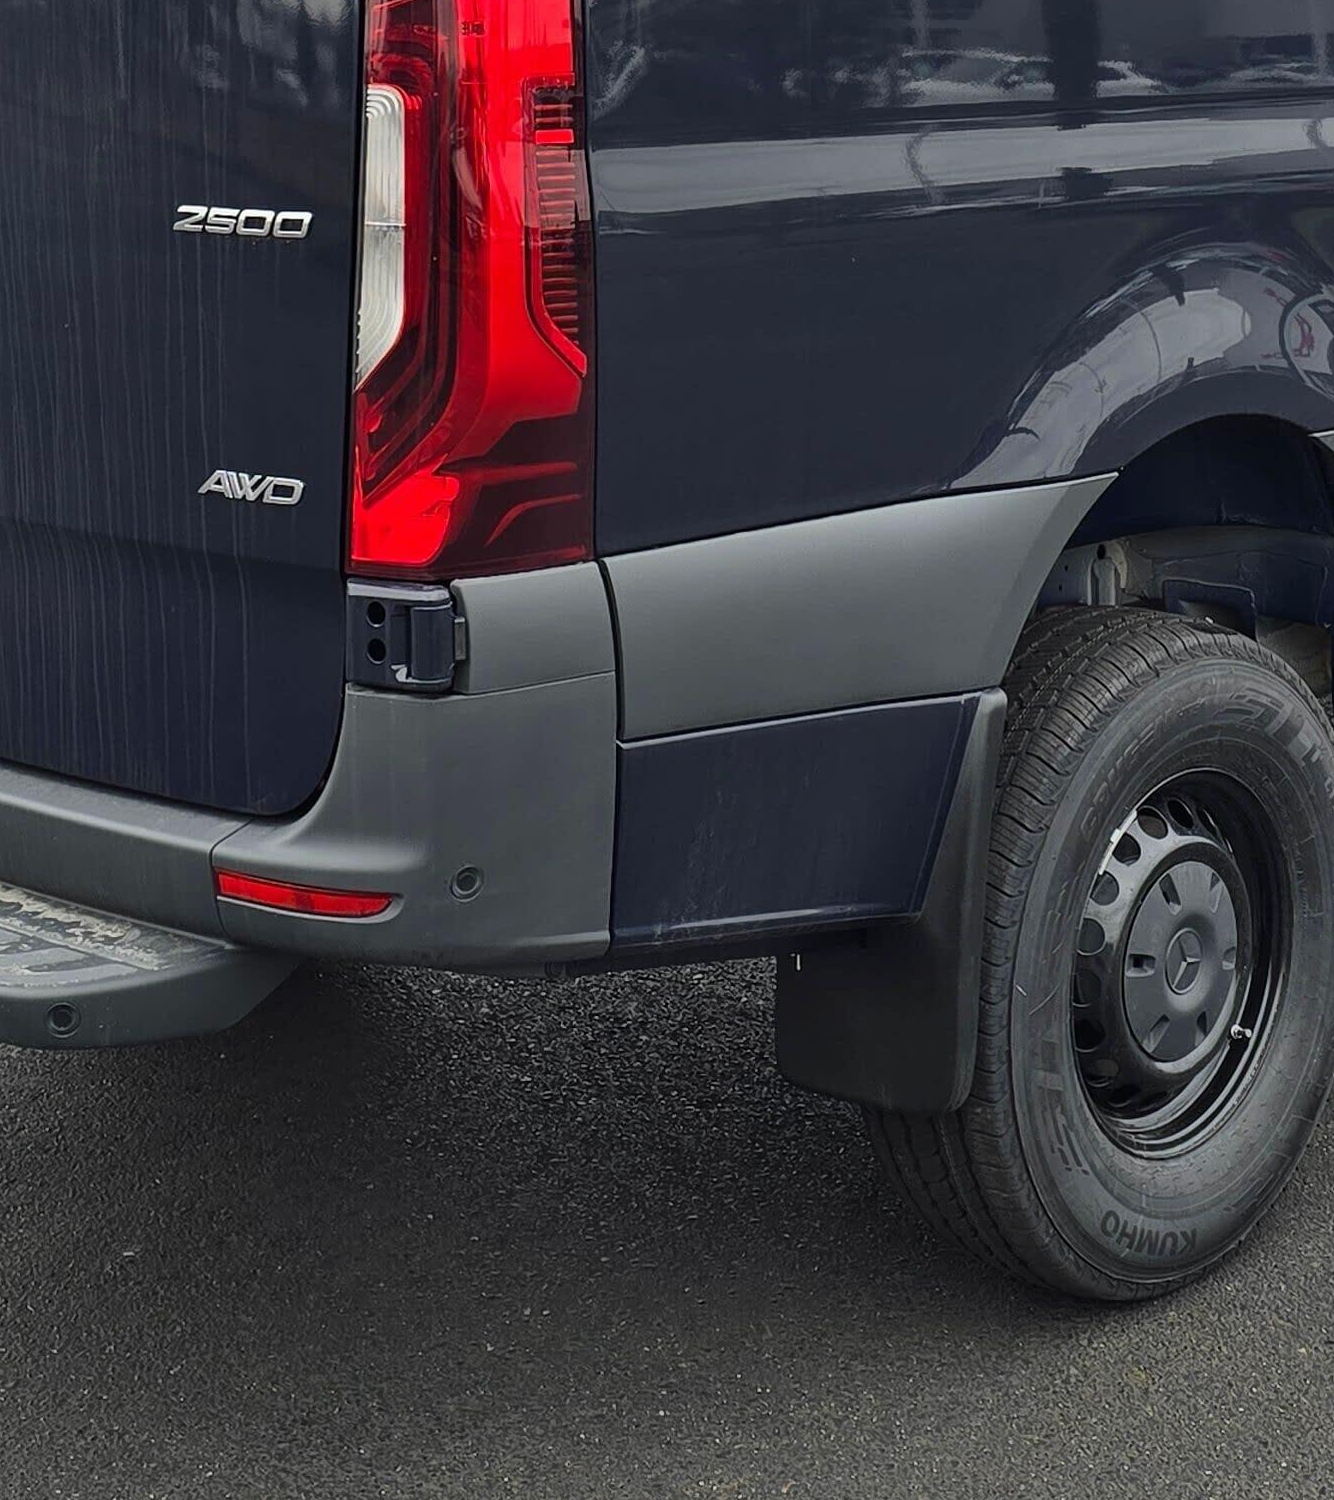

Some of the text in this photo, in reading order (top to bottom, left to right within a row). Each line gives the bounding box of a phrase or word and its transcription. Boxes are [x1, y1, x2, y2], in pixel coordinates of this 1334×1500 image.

[172, 204, 313, 239] 2500
[197, 469, 307, 505] AWD
[1100, 1209, 1198, 1256] KUMHO
